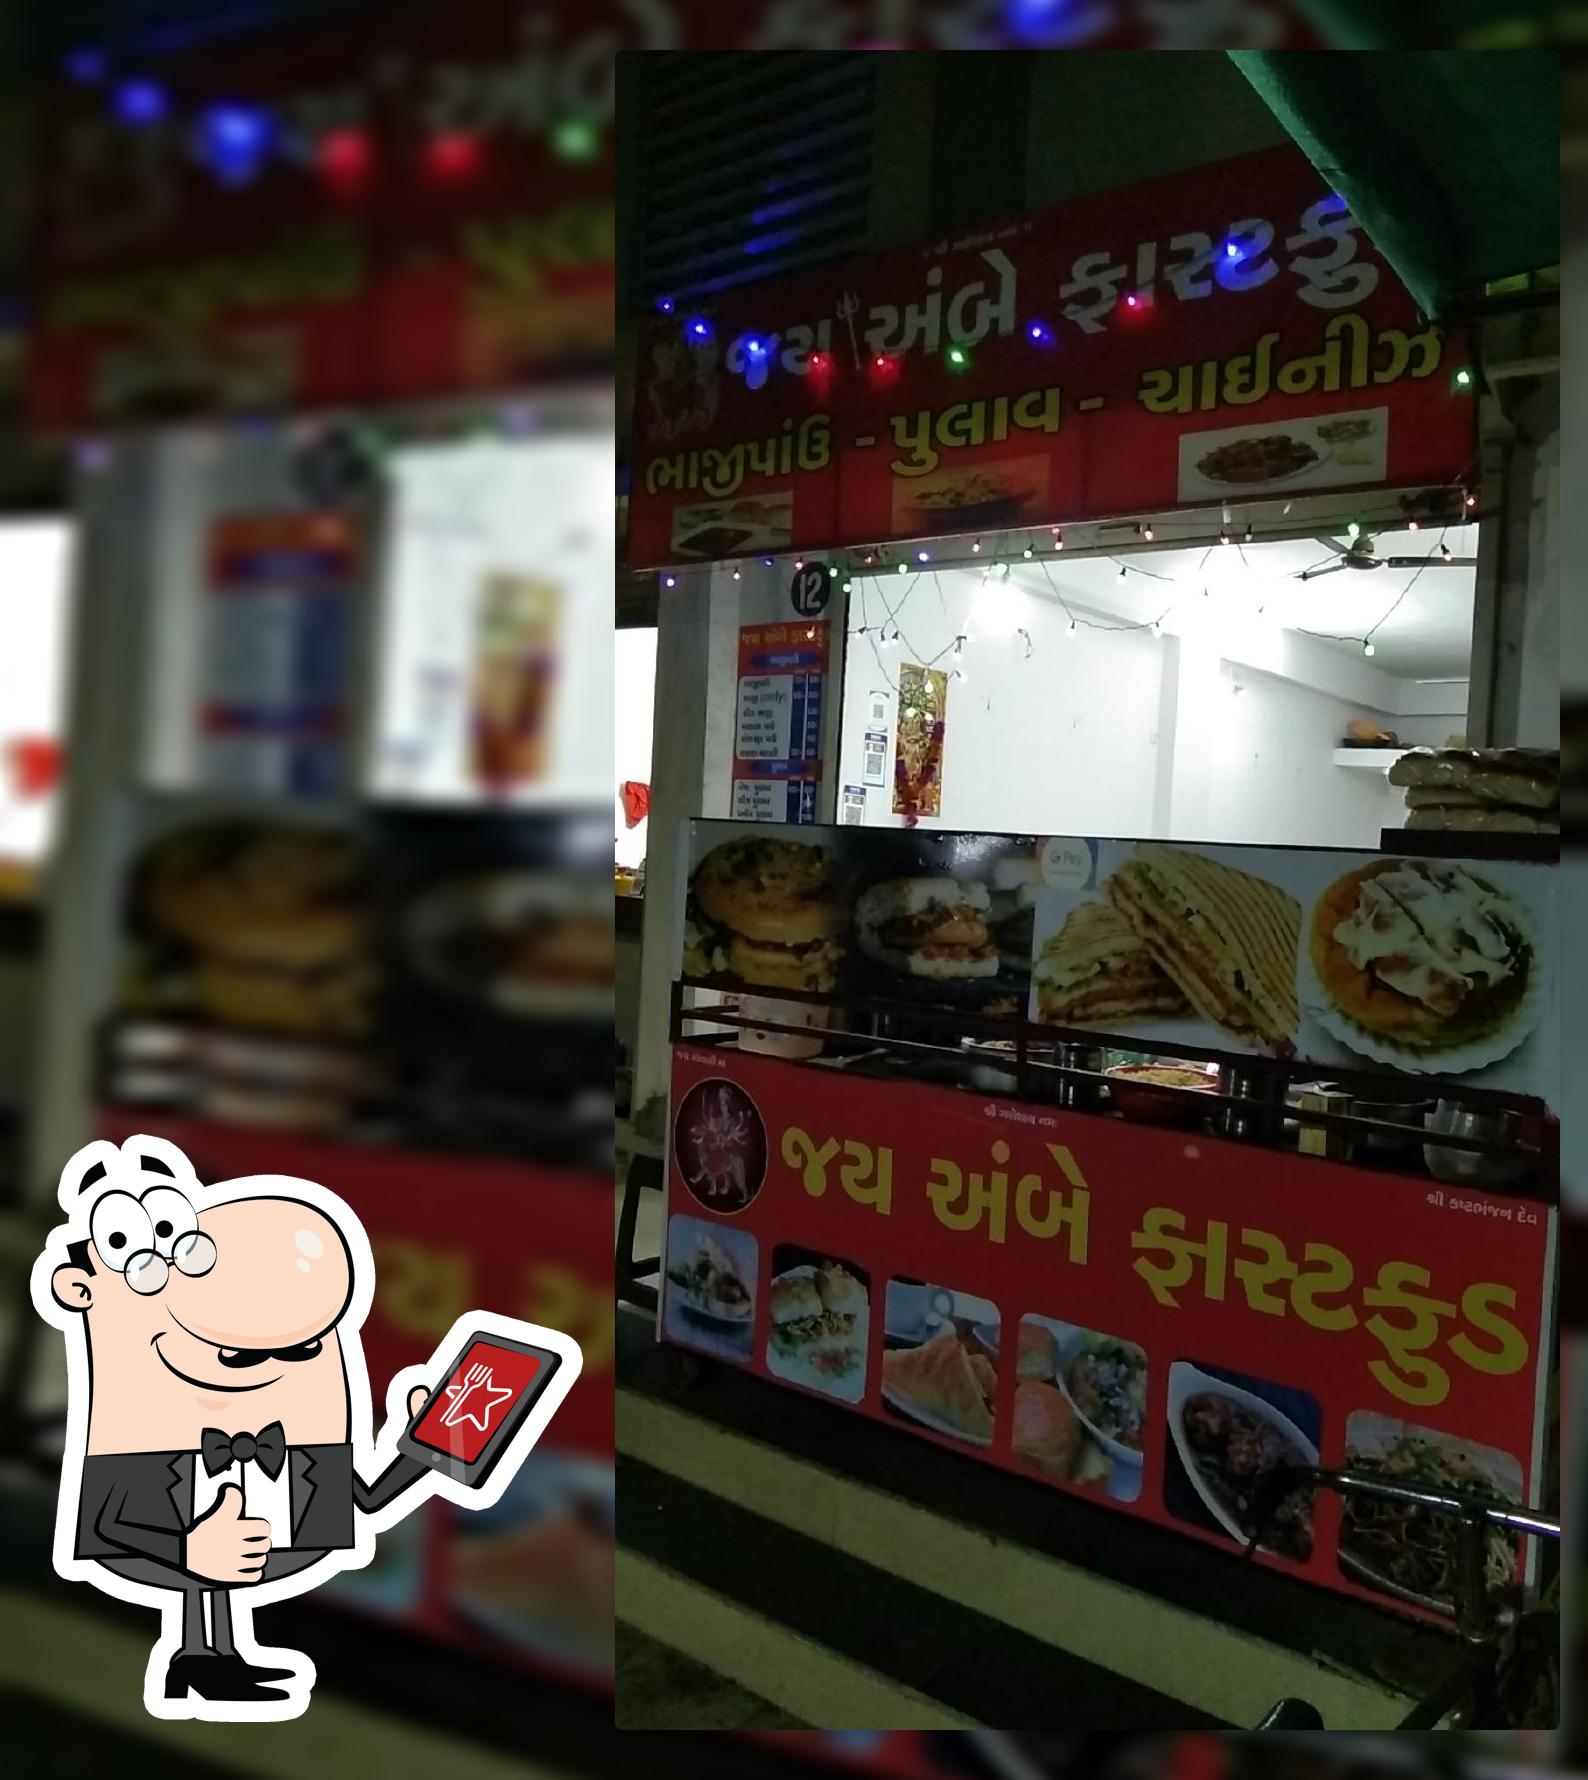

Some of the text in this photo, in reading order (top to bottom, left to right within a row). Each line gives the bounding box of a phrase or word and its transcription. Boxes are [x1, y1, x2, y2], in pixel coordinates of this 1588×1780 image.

[864, 248, 1018, 356] અંબે
[1059, 194, 1380, 333] ફાસ્ટફુ
[889, 387, 1061, 476] પુલાવ
[1139, 313, 1441, 415] ચાઈનીઝ
[798, 571, 822, 610] 12
[781, 1125, 1530, 1407] જય અંબે ફાસ્ટફુડ
[1517, 1205, 1537, 1225] દેવ
